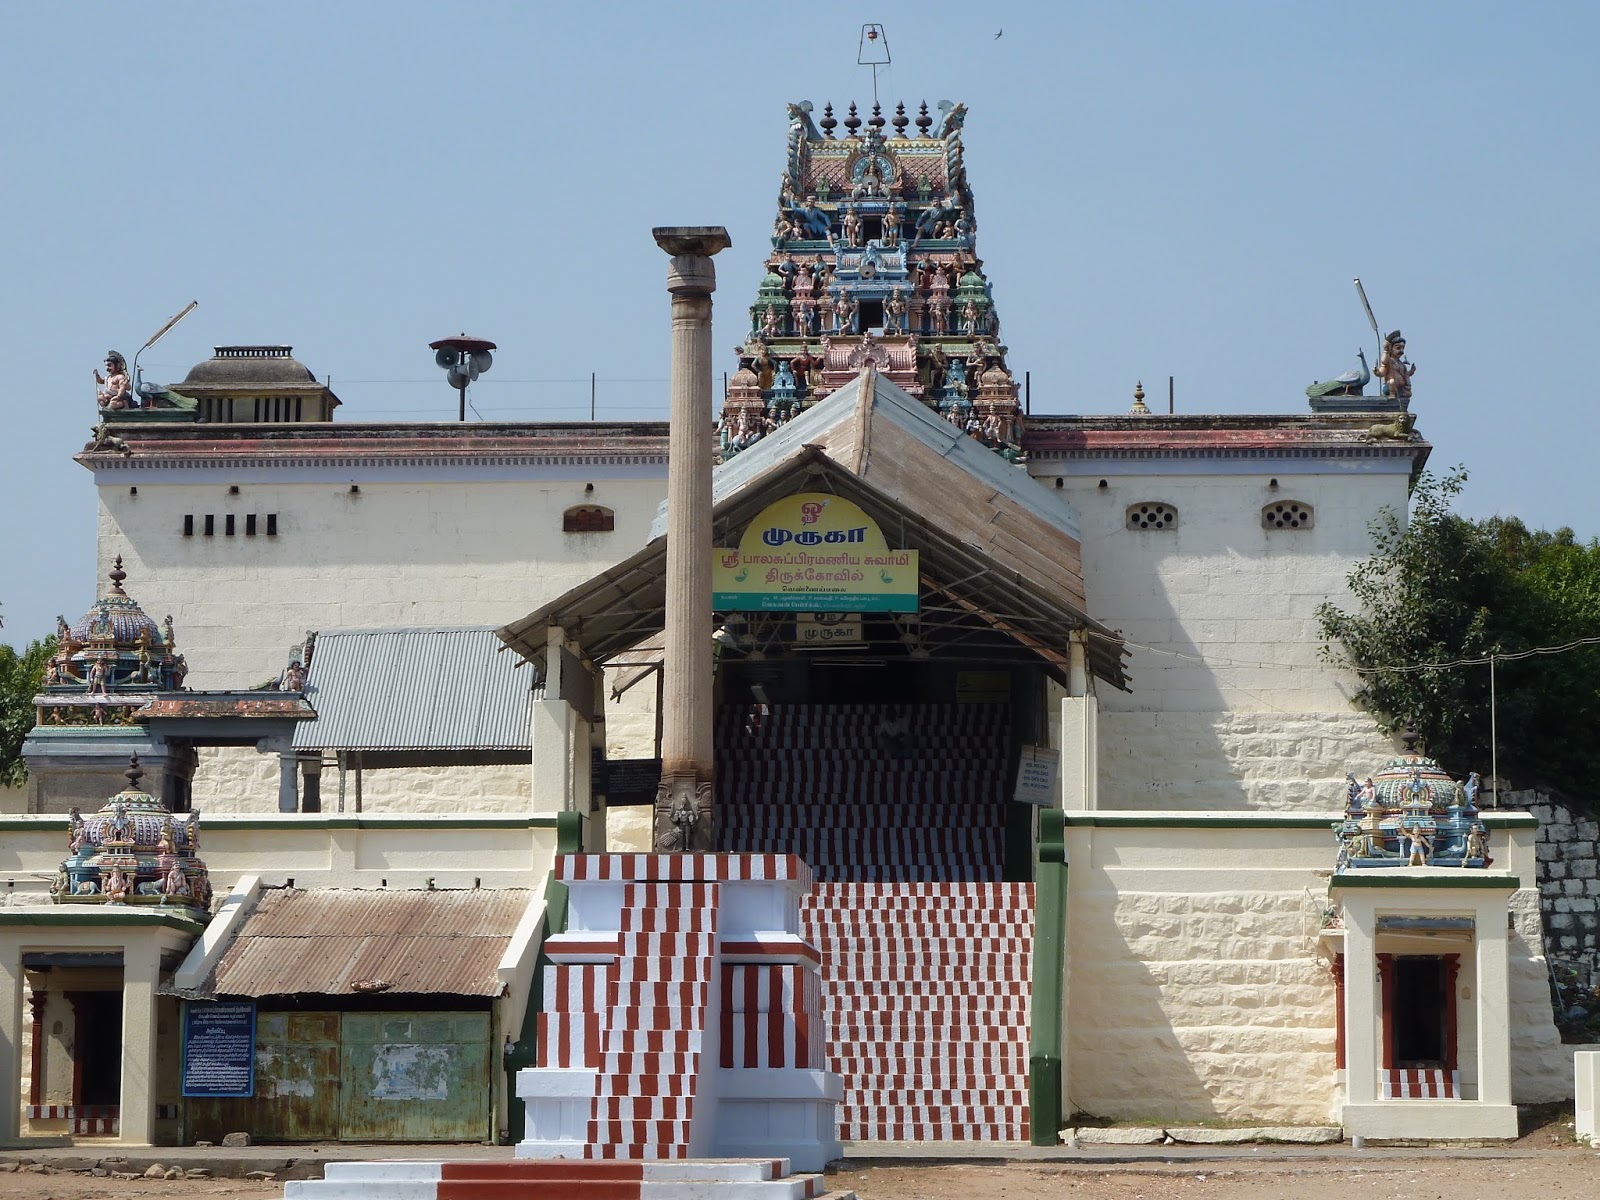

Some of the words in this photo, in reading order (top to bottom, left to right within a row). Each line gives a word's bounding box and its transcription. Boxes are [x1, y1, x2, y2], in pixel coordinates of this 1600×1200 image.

[762, 526, 868, 547] முருகா
[743, 551, 860, 566] பாலசுப்பிரமணிய
[864, 552, 909, 566] சுவாமி
[765, 568, 864, 584] திருக்கோவில்
[804, 628, 854, 640] முருகா
